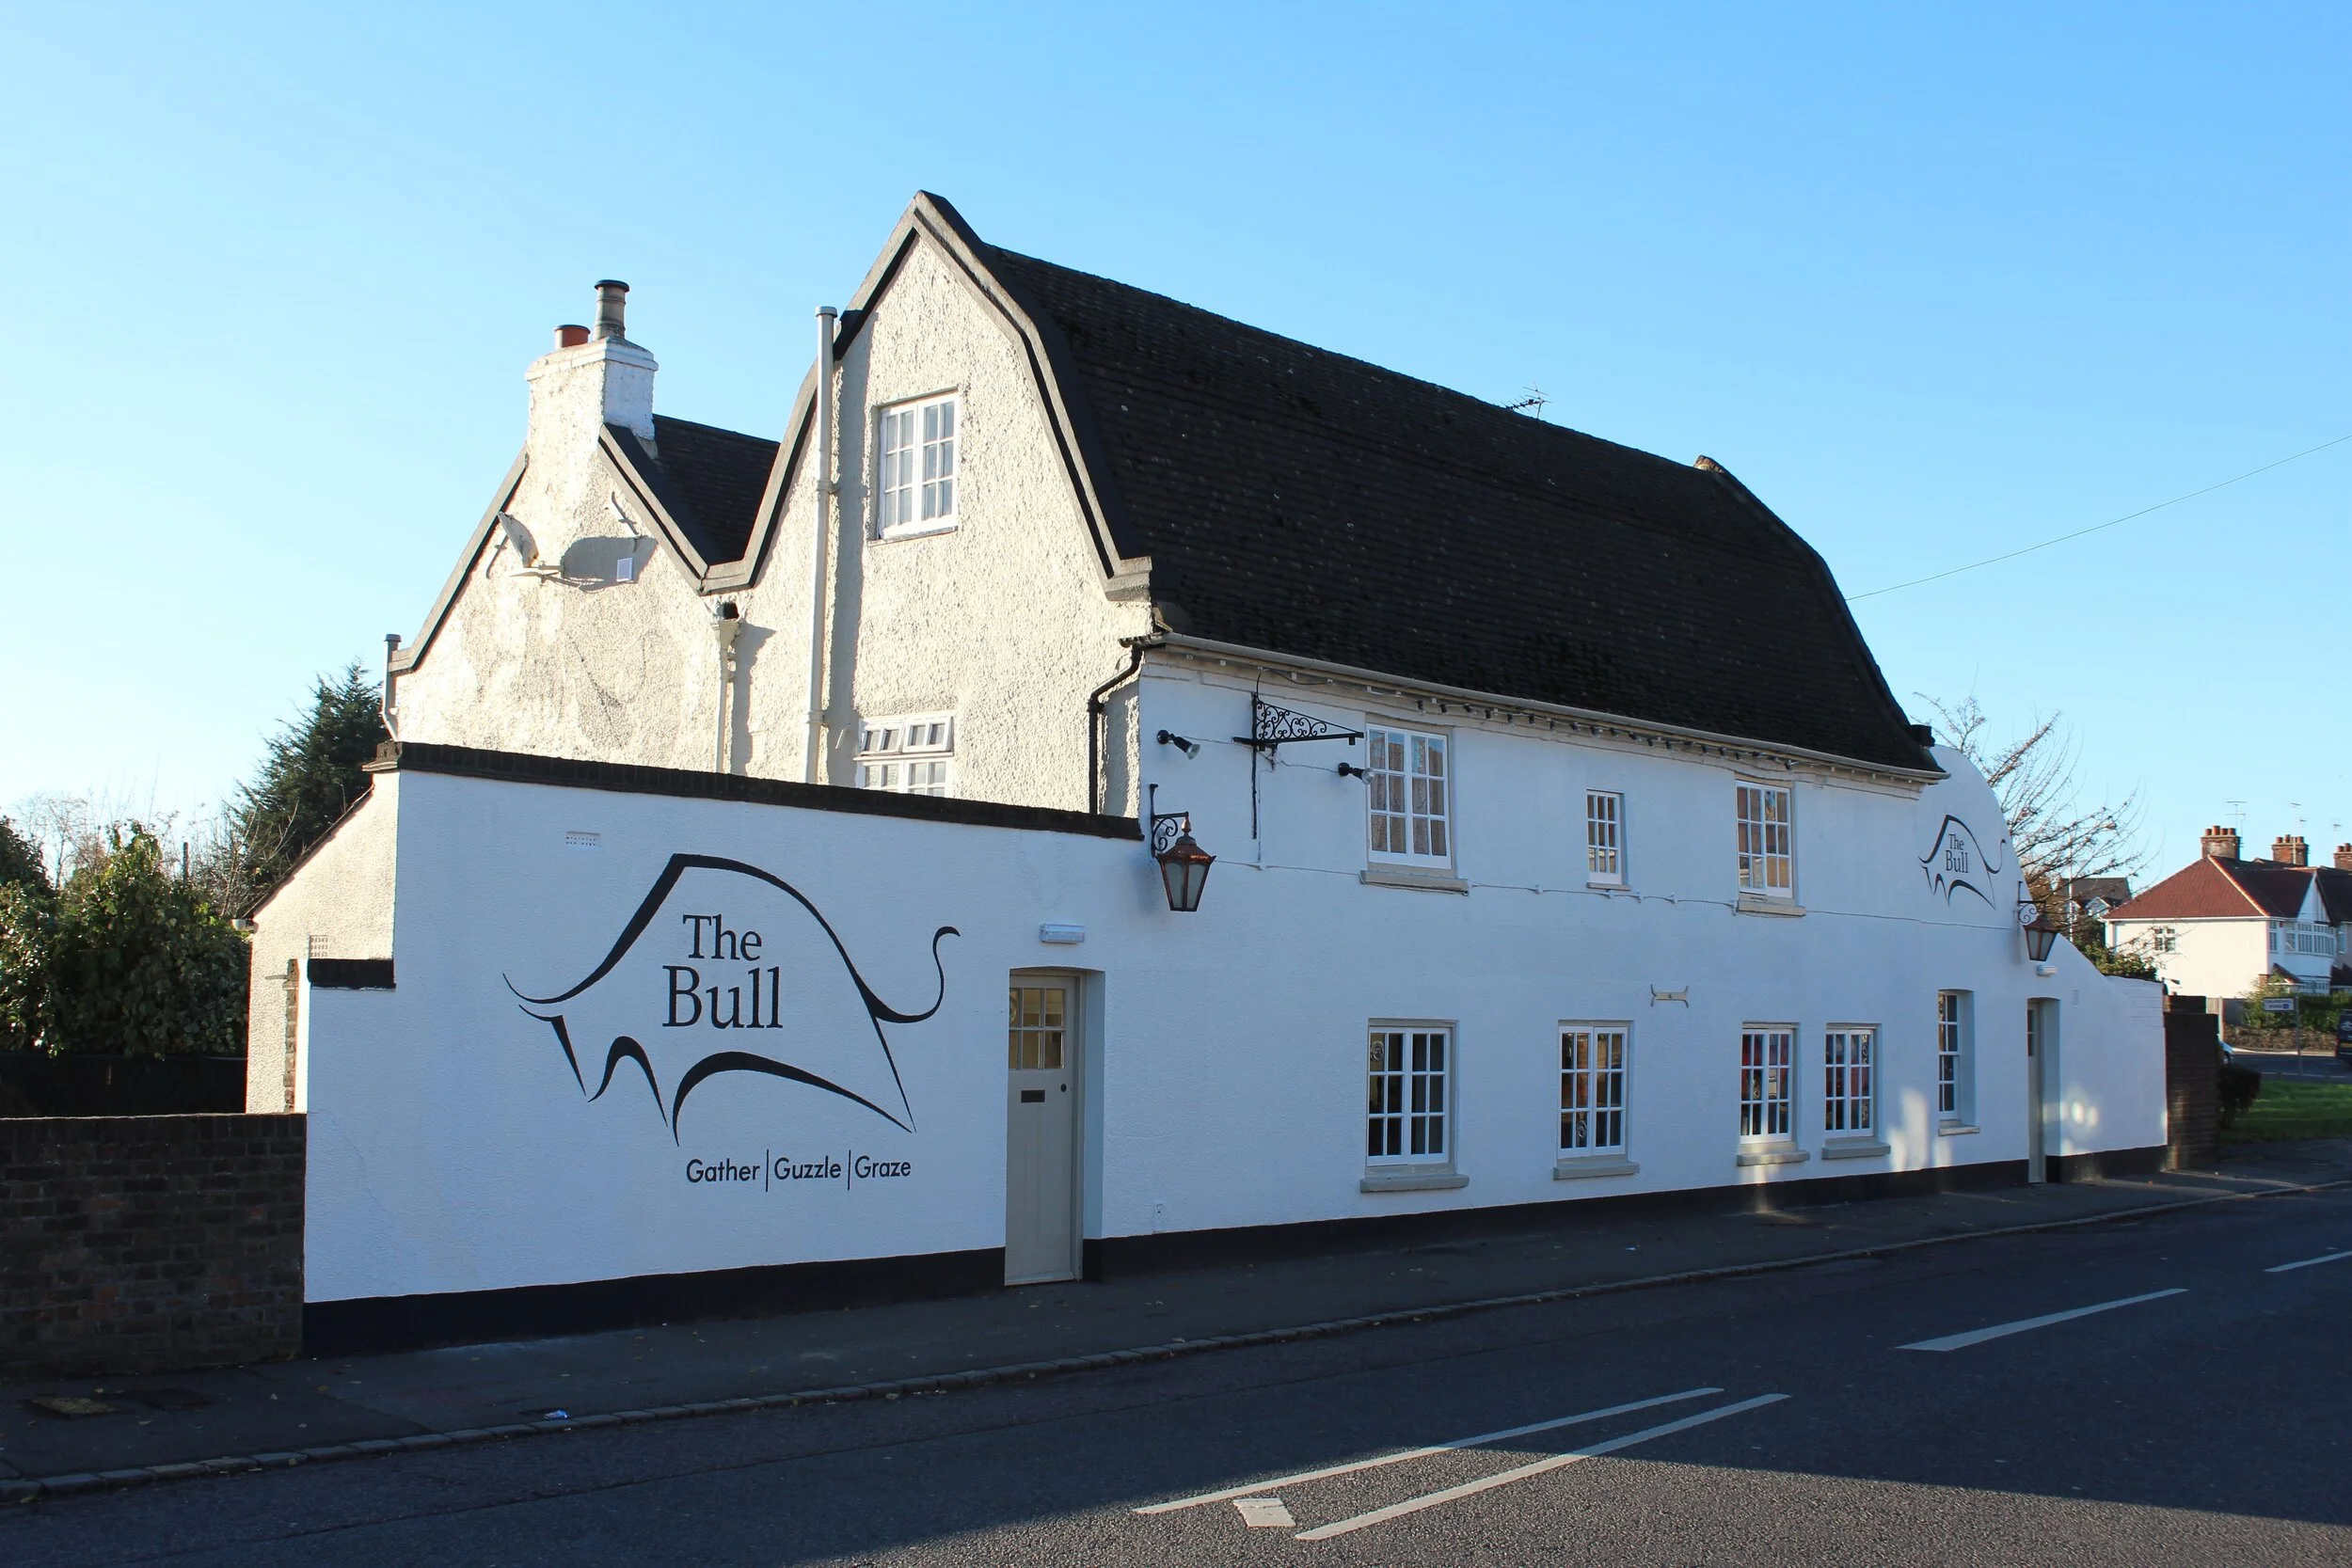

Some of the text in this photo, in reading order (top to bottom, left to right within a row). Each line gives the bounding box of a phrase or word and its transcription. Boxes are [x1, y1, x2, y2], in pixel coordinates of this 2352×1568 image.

[1948, 833, 1964, 850] The
[1946, 850, 1968, 873] Bull
[681, 912, 763, 962] The
[661, 964, 785, 1030] Bull
[685, 1154, 913, 1184] Gather Guzzle Graze
